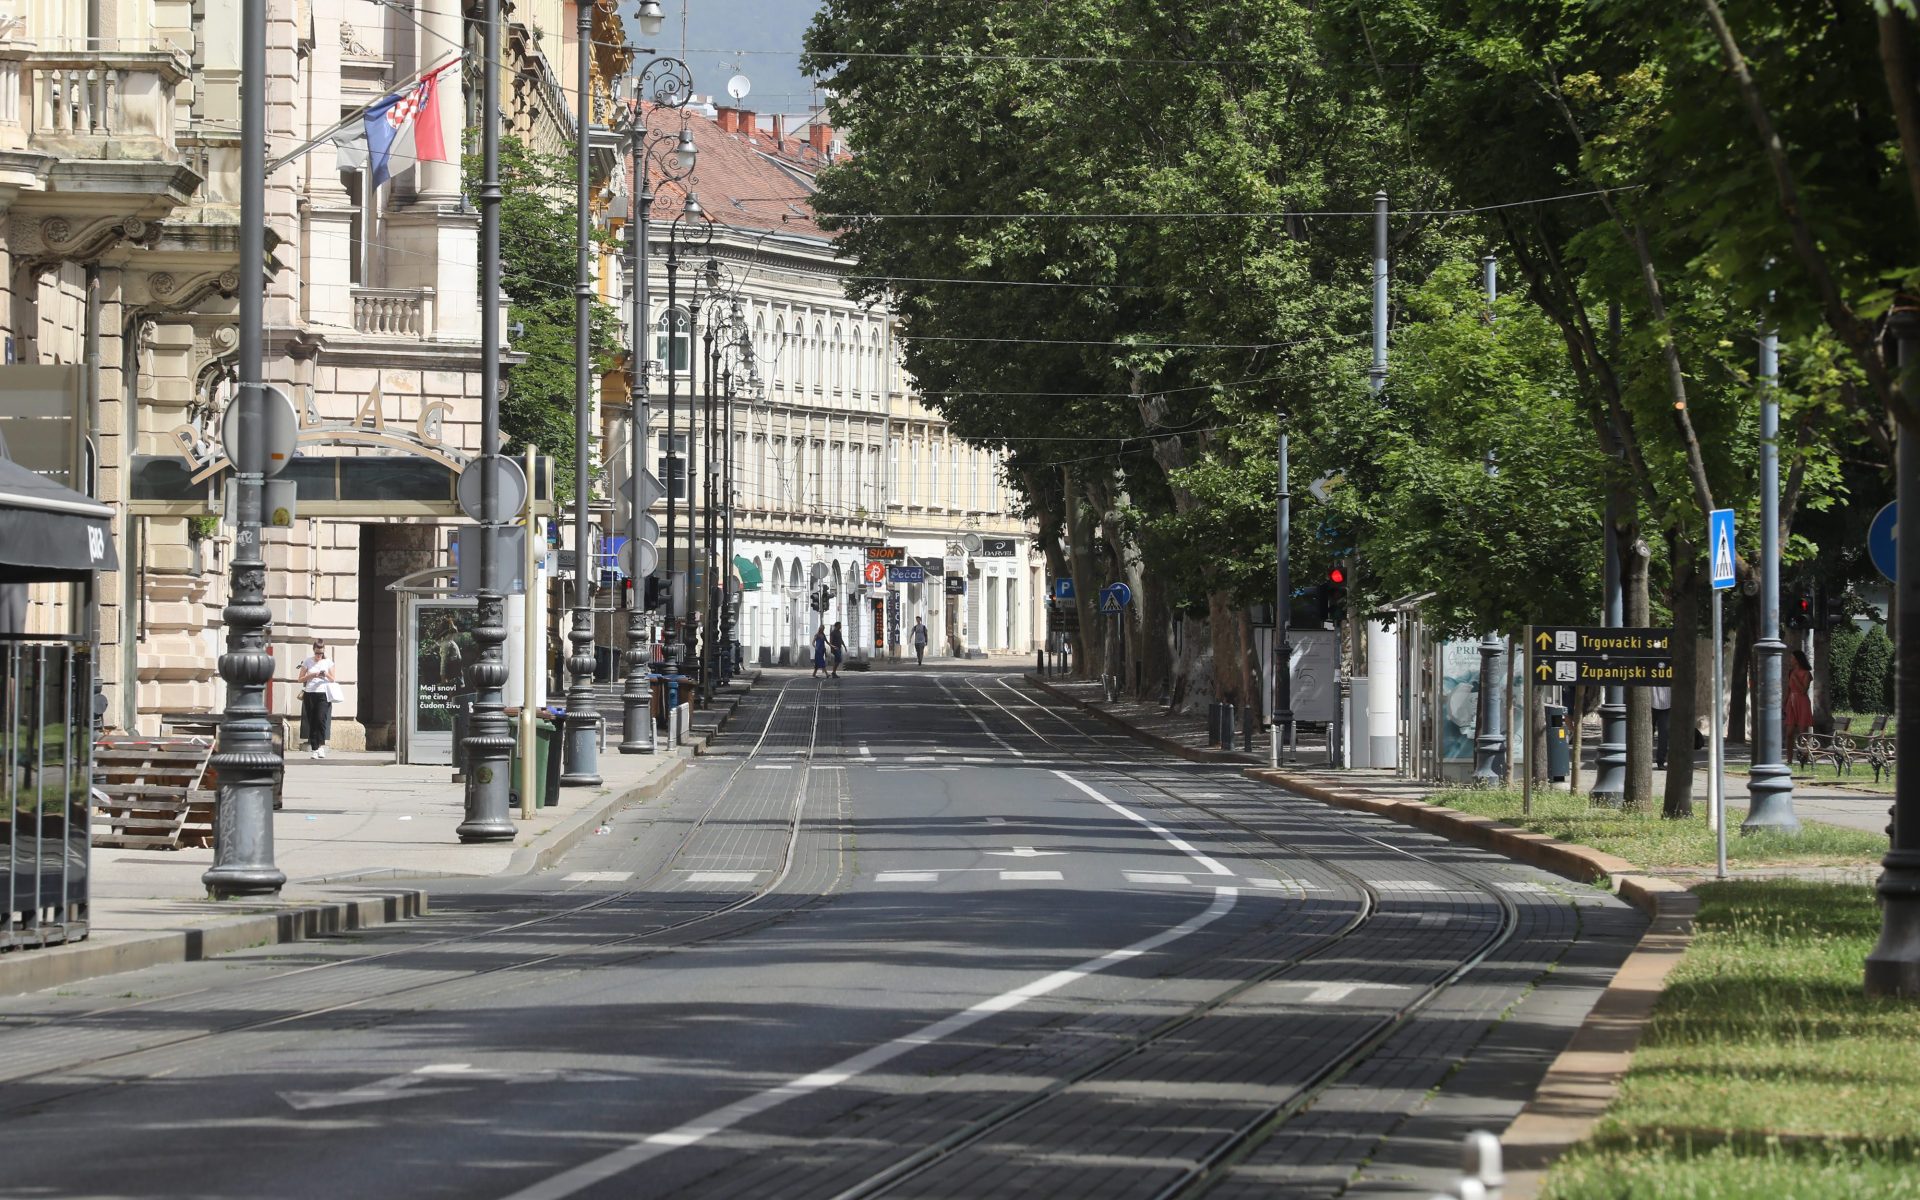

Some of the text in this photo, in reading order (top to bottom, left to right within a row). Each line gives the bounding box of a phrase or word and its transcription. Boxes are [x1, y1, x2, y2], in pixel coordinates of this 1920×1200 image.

[1061, 581, 1070, 594] P
[1581, 635, 1641, 650] Trgovački
[1581, 662, 1673, 681] Županijski sud
[420, 684, 436, 692] Moji
[433, 692, 448, 700] čine
[420, 701, 445, 709] čudom
